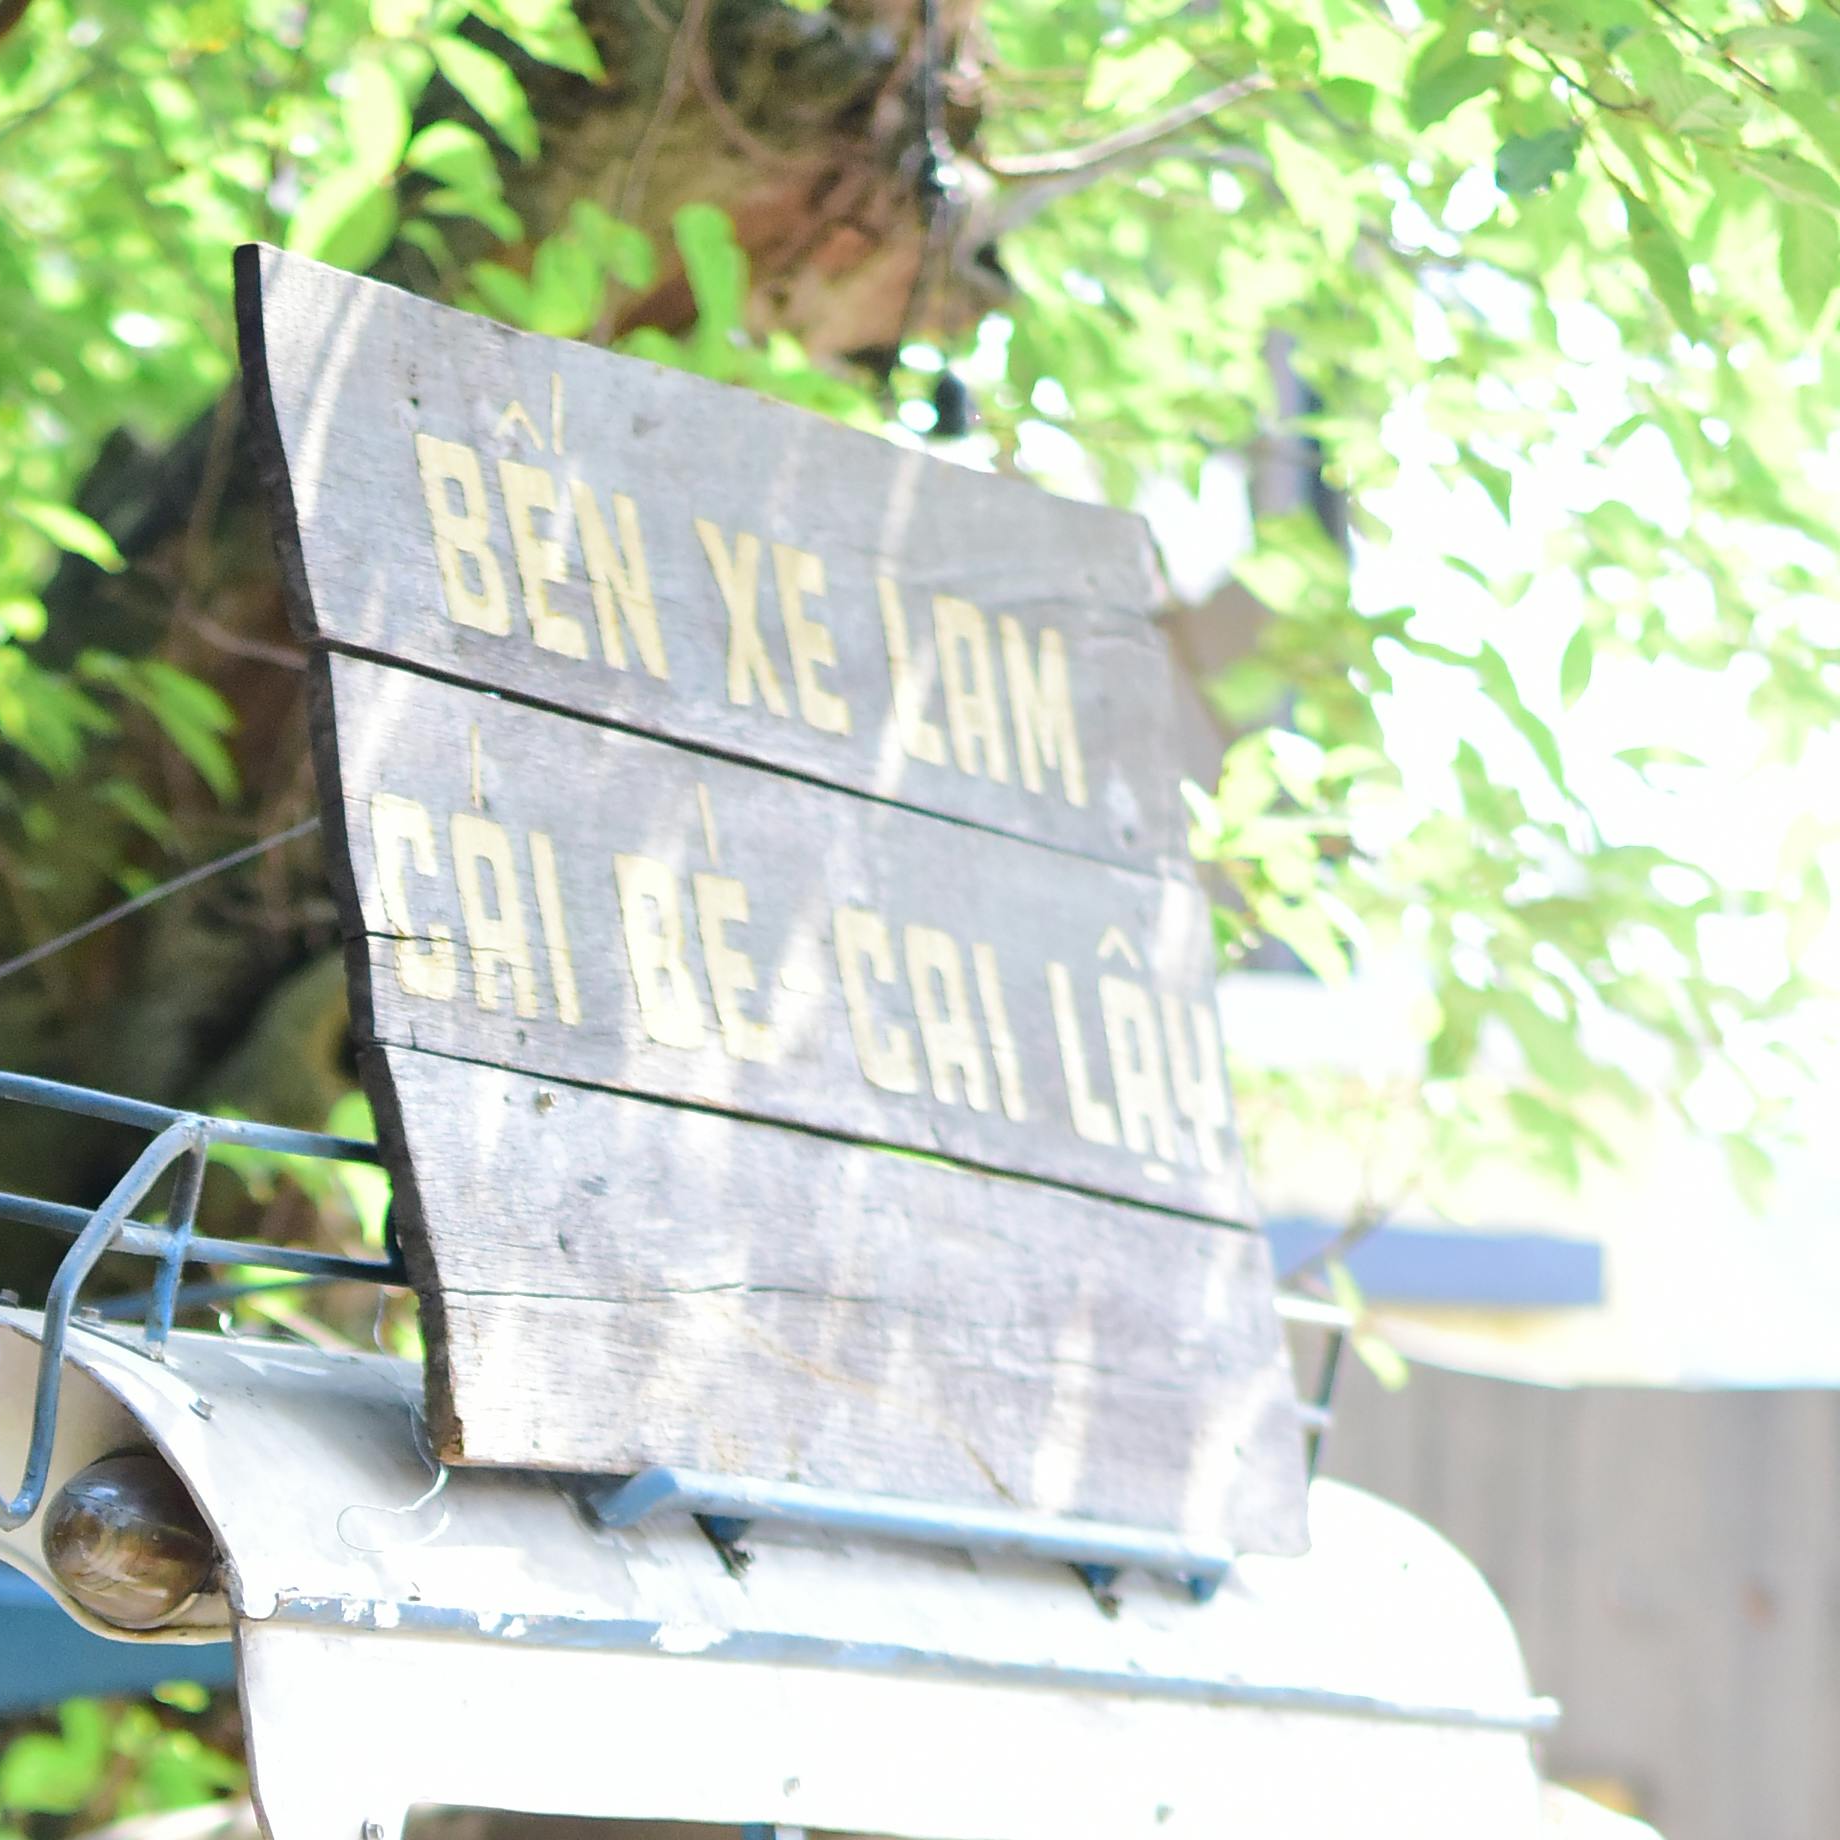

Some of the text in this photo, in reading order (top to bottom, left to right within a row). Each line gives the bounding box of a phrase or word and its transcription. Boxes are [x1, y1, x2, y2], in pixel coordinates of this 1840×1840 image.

[412, 374, 1087, 806] BẾN XE LAM
[371, 725, 581, 1026] CÁI
[834, 904, 1025, 1121] CAI
